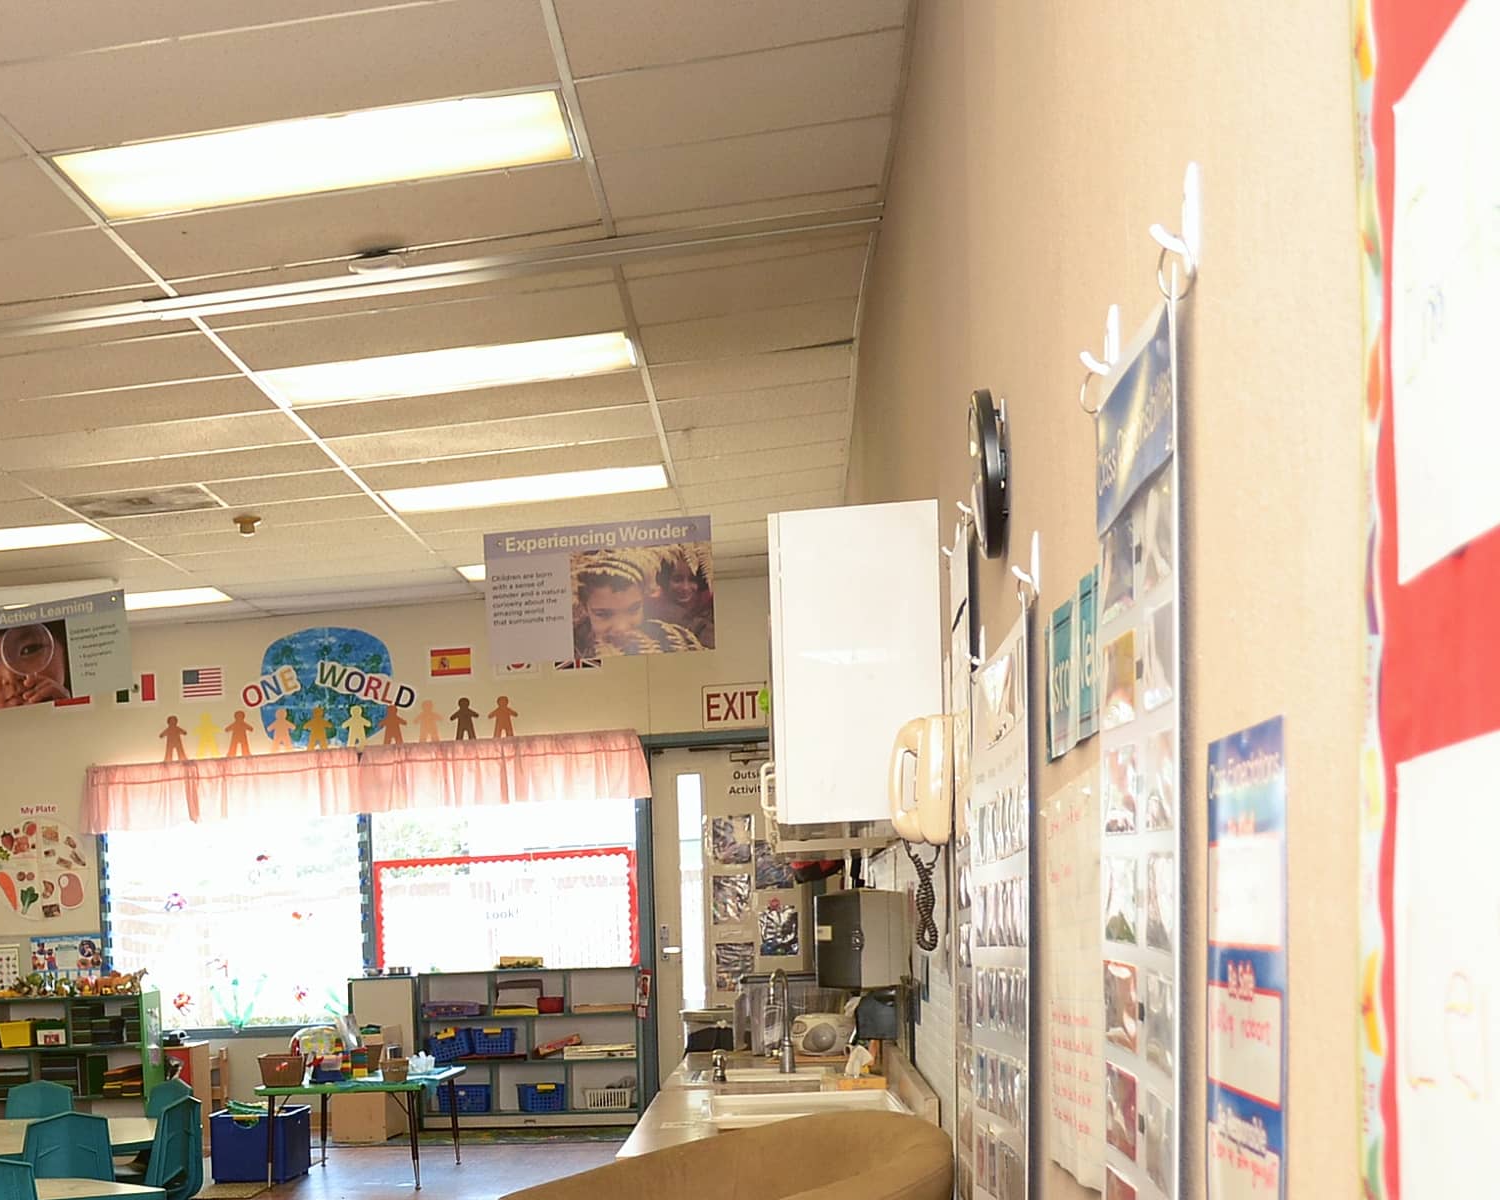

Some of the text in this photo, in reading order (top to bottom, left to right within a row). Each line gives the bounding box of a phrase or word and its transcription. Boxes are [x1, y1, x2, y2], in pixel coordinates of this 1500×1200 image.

[505, 524, 689, 553] Experiencing Wonder
[0, 600, 93, 625] Active Learning
[242, 662, 415, 708] ONE WORLD
[706, 691, 759, 721] EXIT
[733, 769, 762, 780] Outsi
[729, 784, 768, 794] Activit
